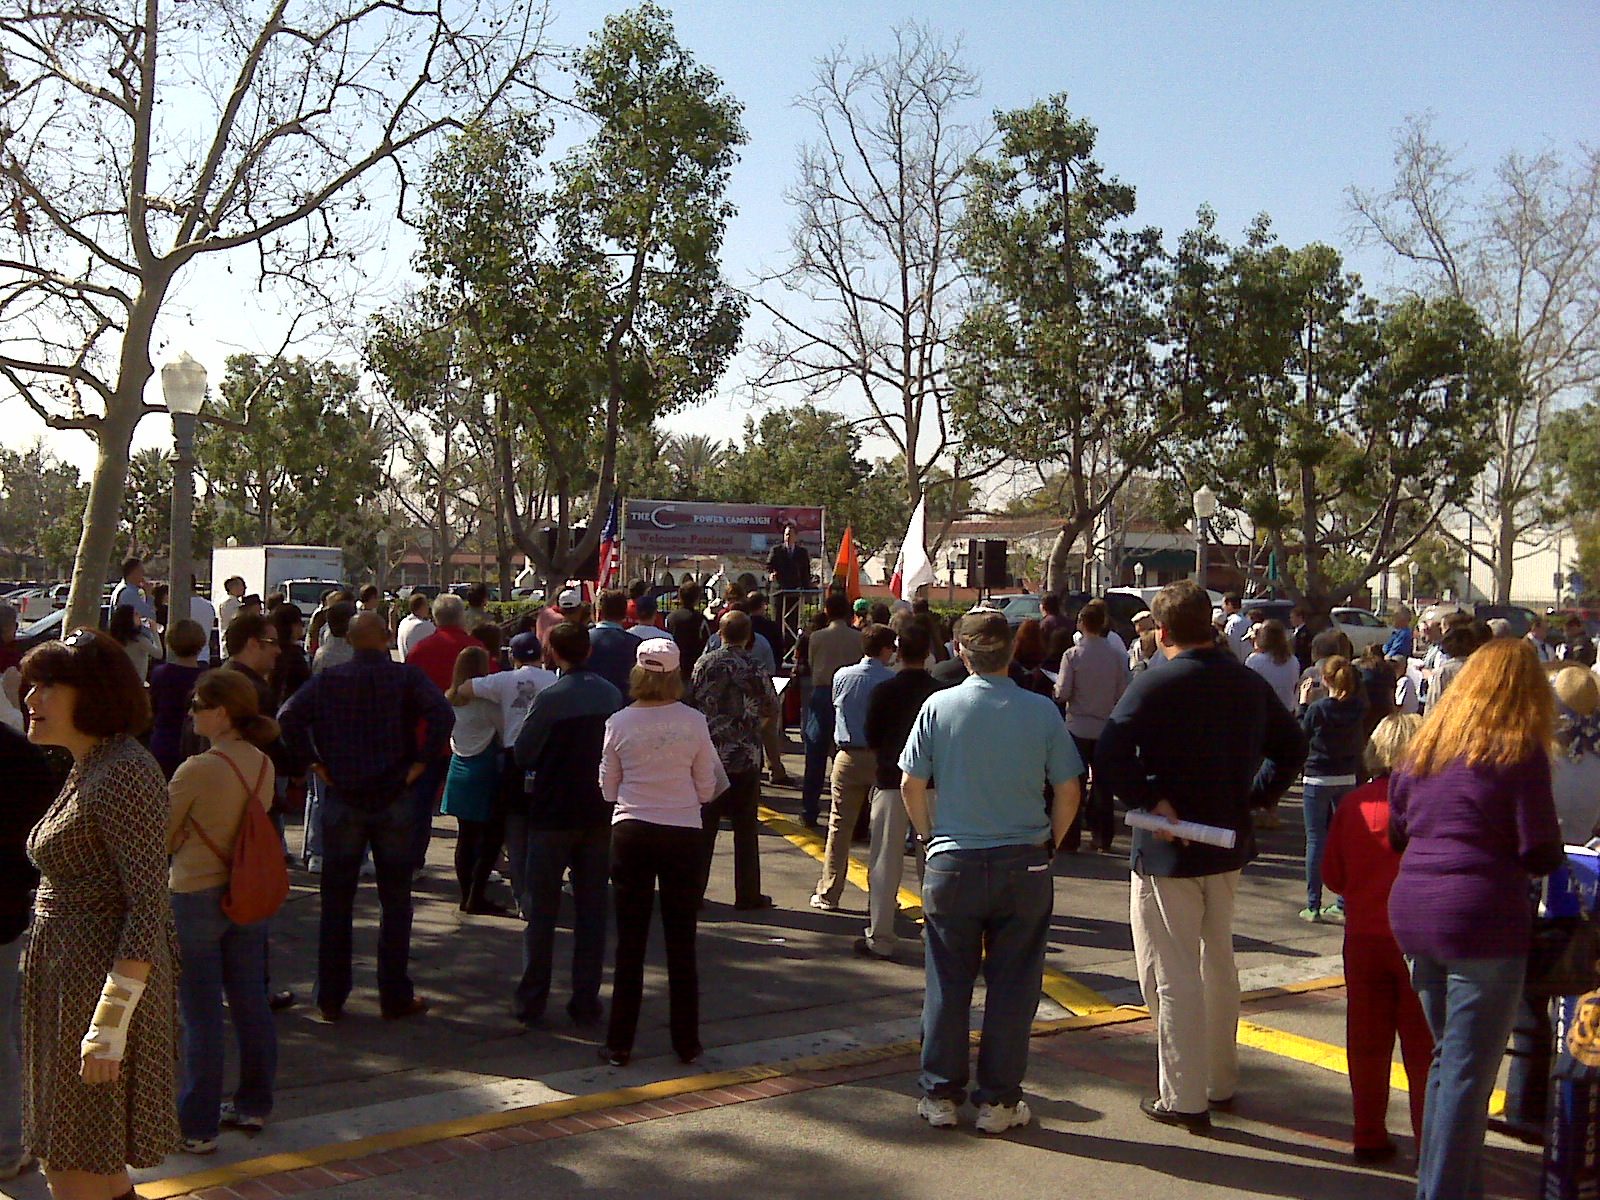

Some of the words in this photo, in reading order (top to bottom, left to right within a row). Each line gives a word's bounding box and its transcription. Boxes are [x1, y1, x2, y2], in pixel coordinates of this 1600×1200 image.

[631, 512, 651, 521] THE
[693, 515, 724, 524] POWER
[725, 516, 771, 525] CAMPAIGN
[638, 533, 687, 544] Welcome
